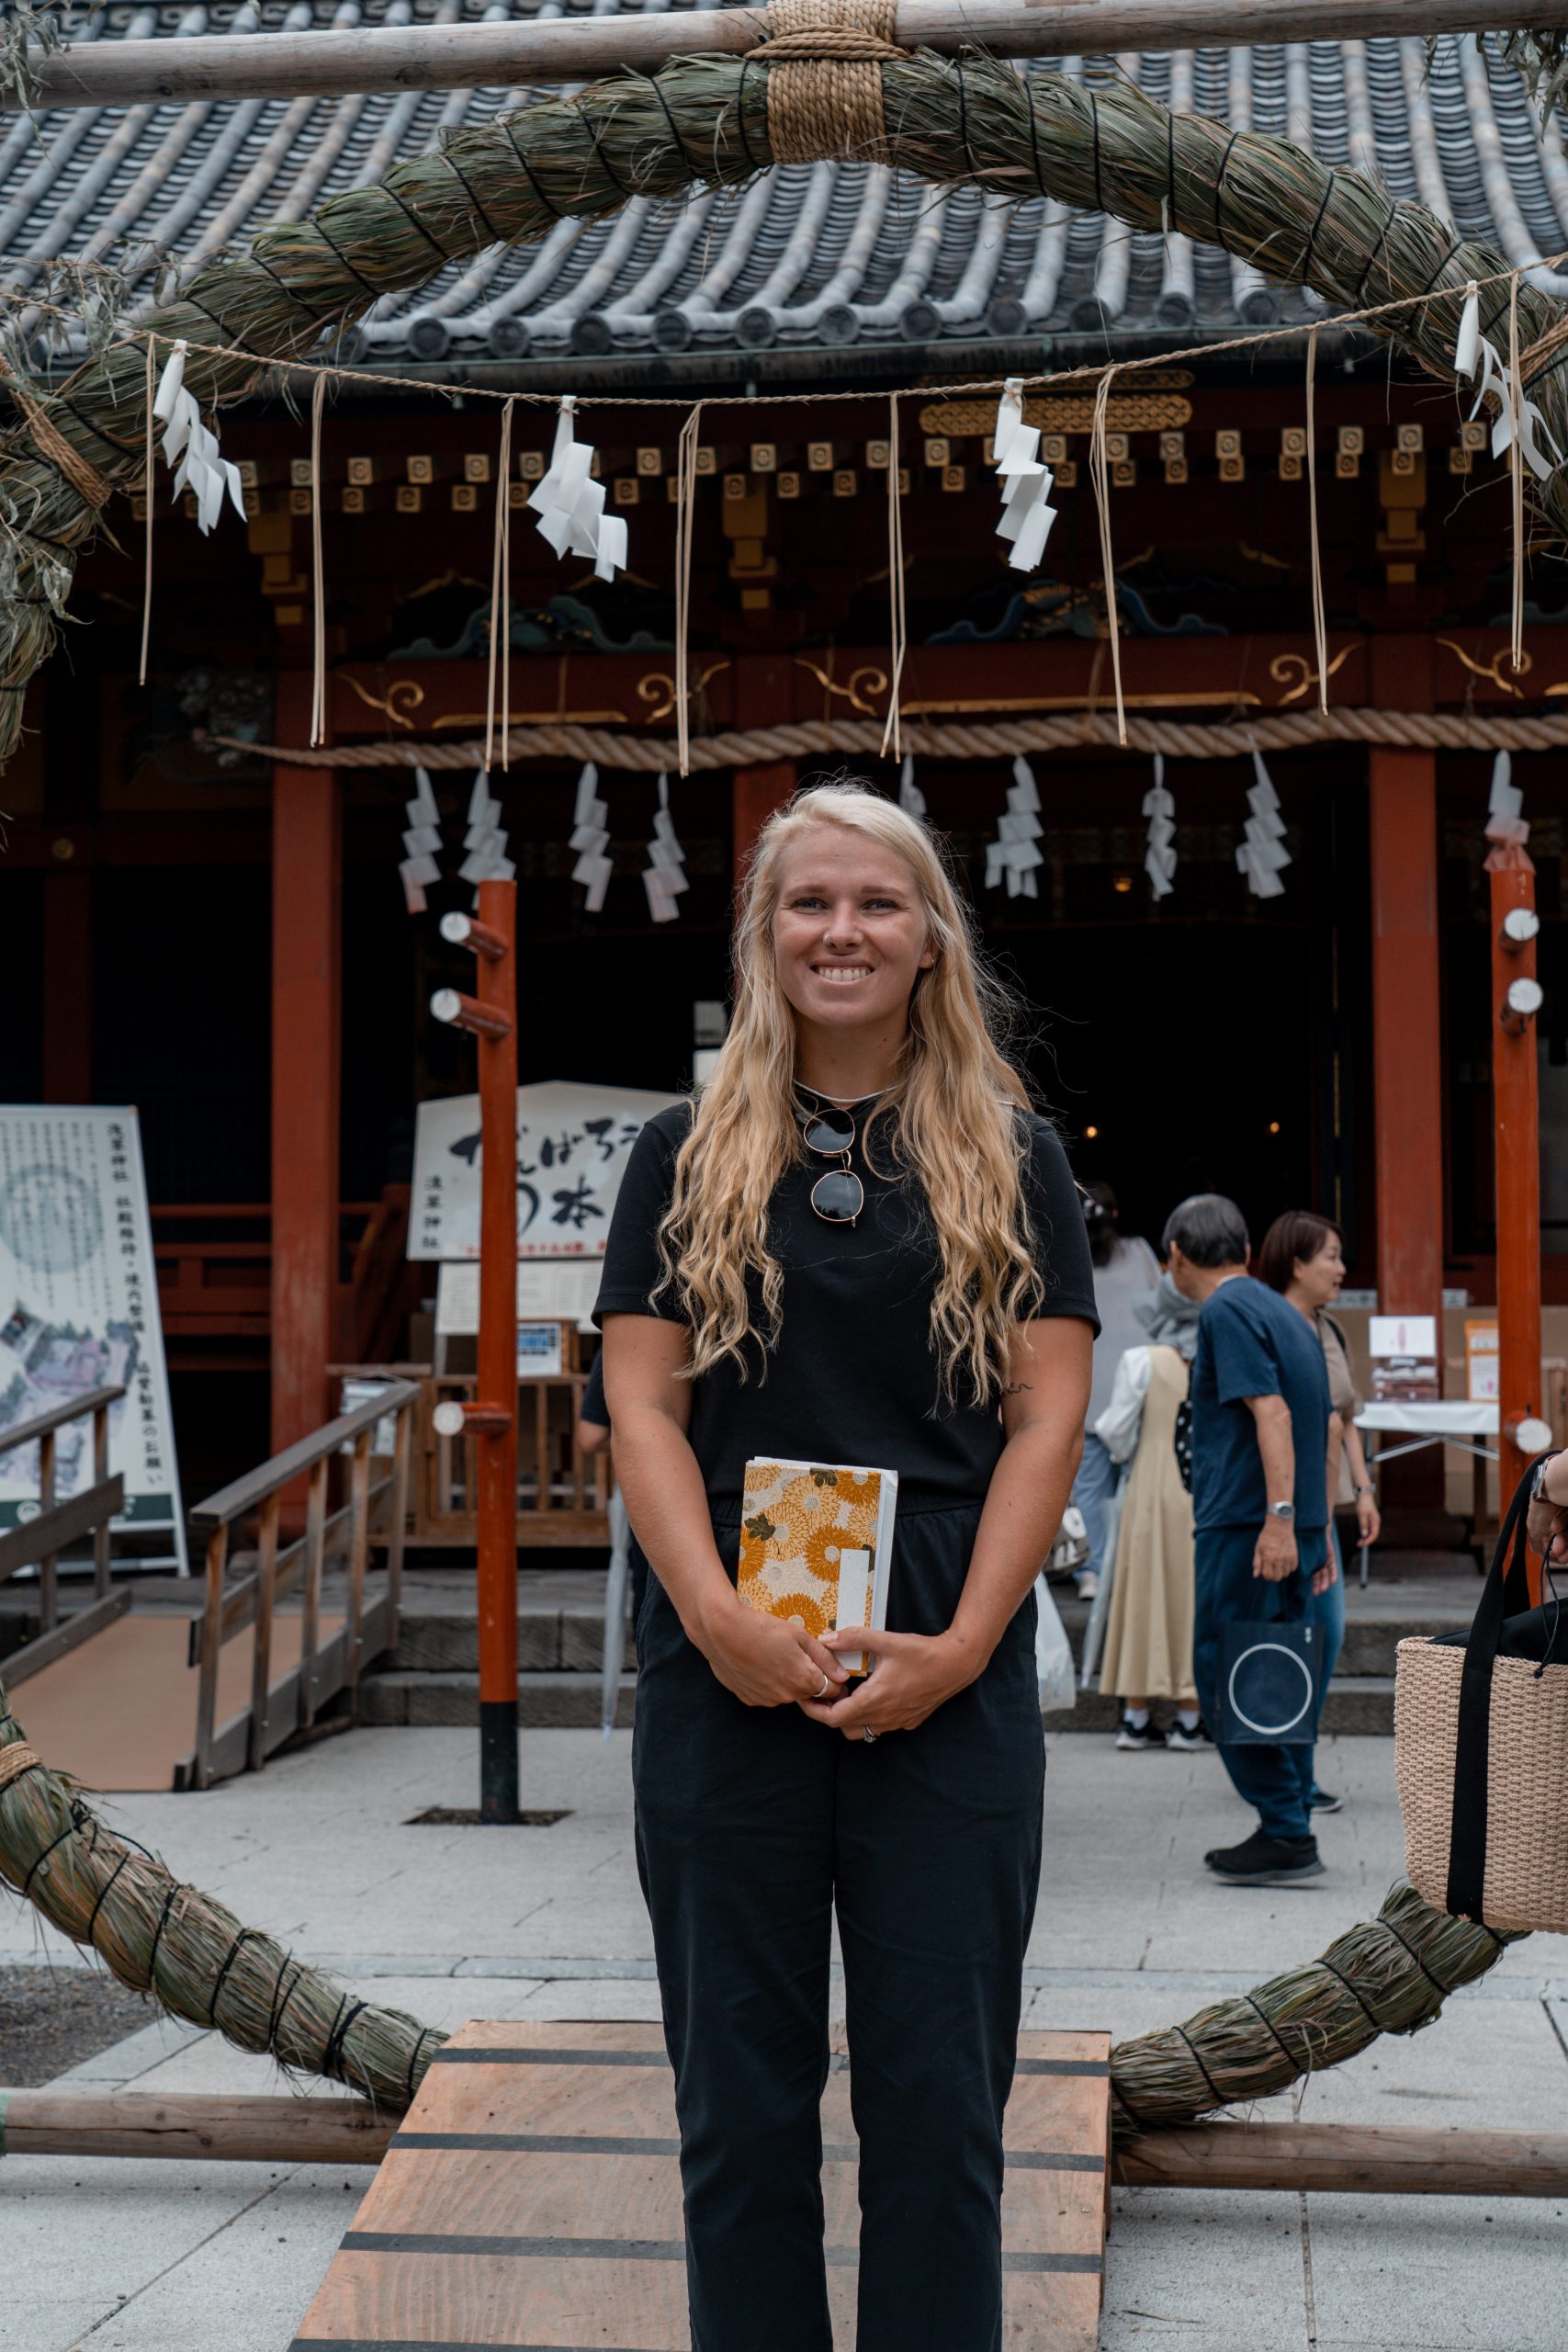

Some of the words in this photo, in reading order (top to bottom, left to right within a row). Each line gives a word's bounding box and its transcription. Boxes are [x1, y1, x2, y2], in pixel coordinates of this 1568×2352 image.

[107, 1123, 129, 1182] 浅草神社
[423, 1175, 443, 1250] 浅草神社
